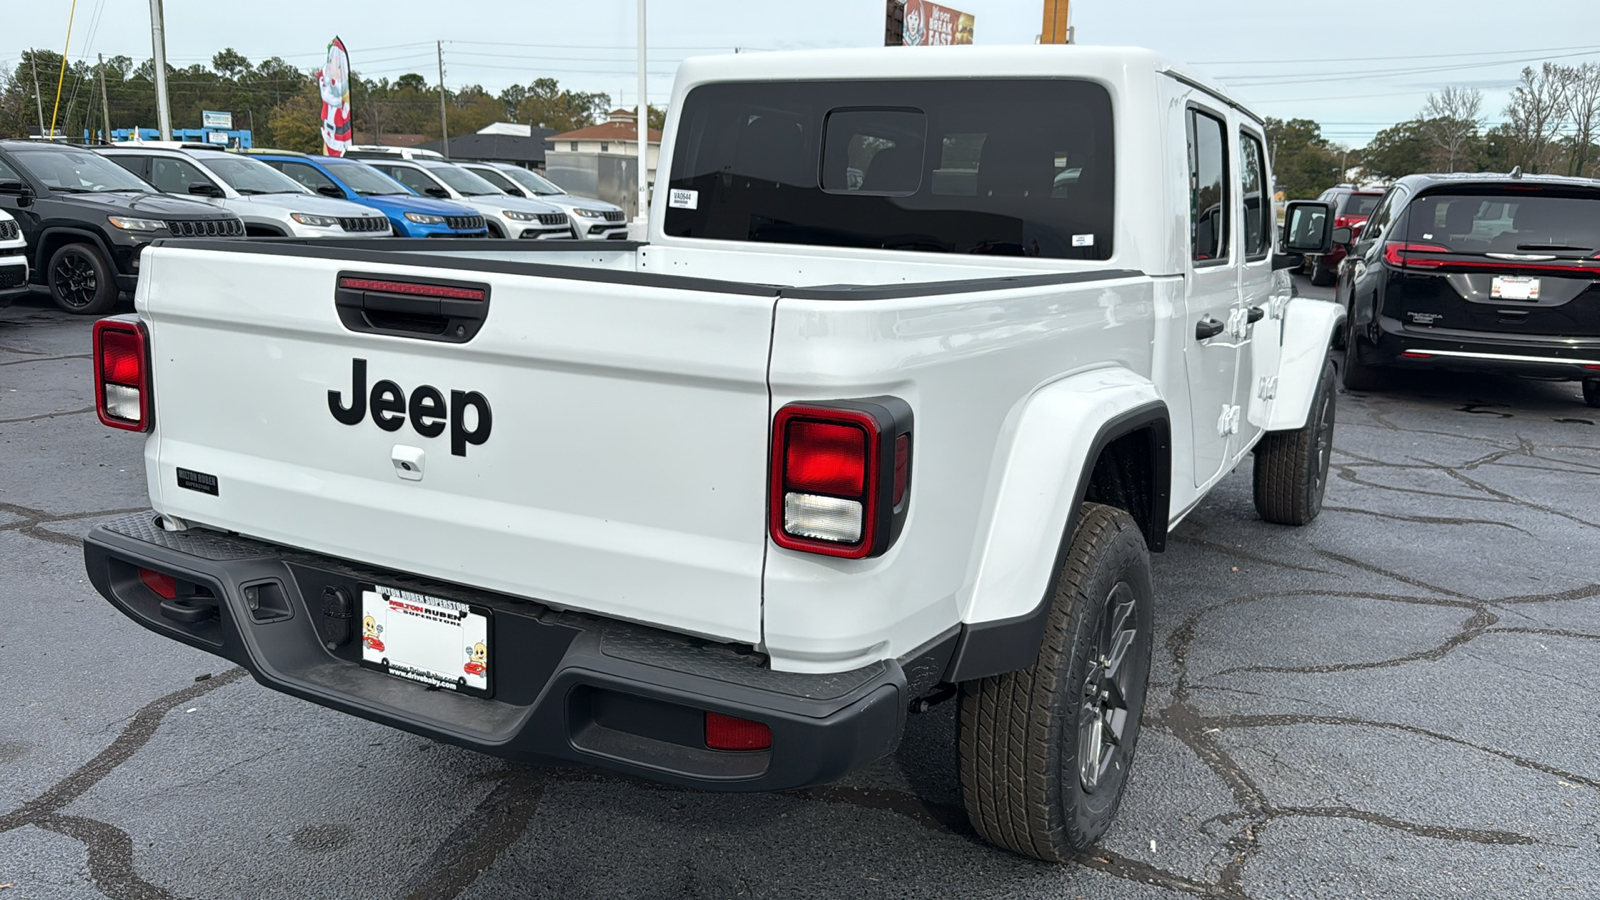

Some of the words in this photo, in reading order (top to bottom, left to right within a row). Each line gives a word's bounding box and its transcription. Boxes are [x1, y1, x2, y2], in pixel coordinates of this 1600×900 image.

[928, 17, 953, 35] BREAK
[928, 30, 953, 46] FAST
[327, 357, 493, 457] Jeep
[375, 585, 400, 598] MILTON
[400, 590, 424, 603] RUBEN
[424, 595, 470, 612] SUPERSTORE
[389, 599, 424, 613] MILTON
[424, 607, 462, 621] RUBEN
[403, 610, 462, 627] SUPERSTORE
[388, 667, 457, 690] www.drivebaby.com
